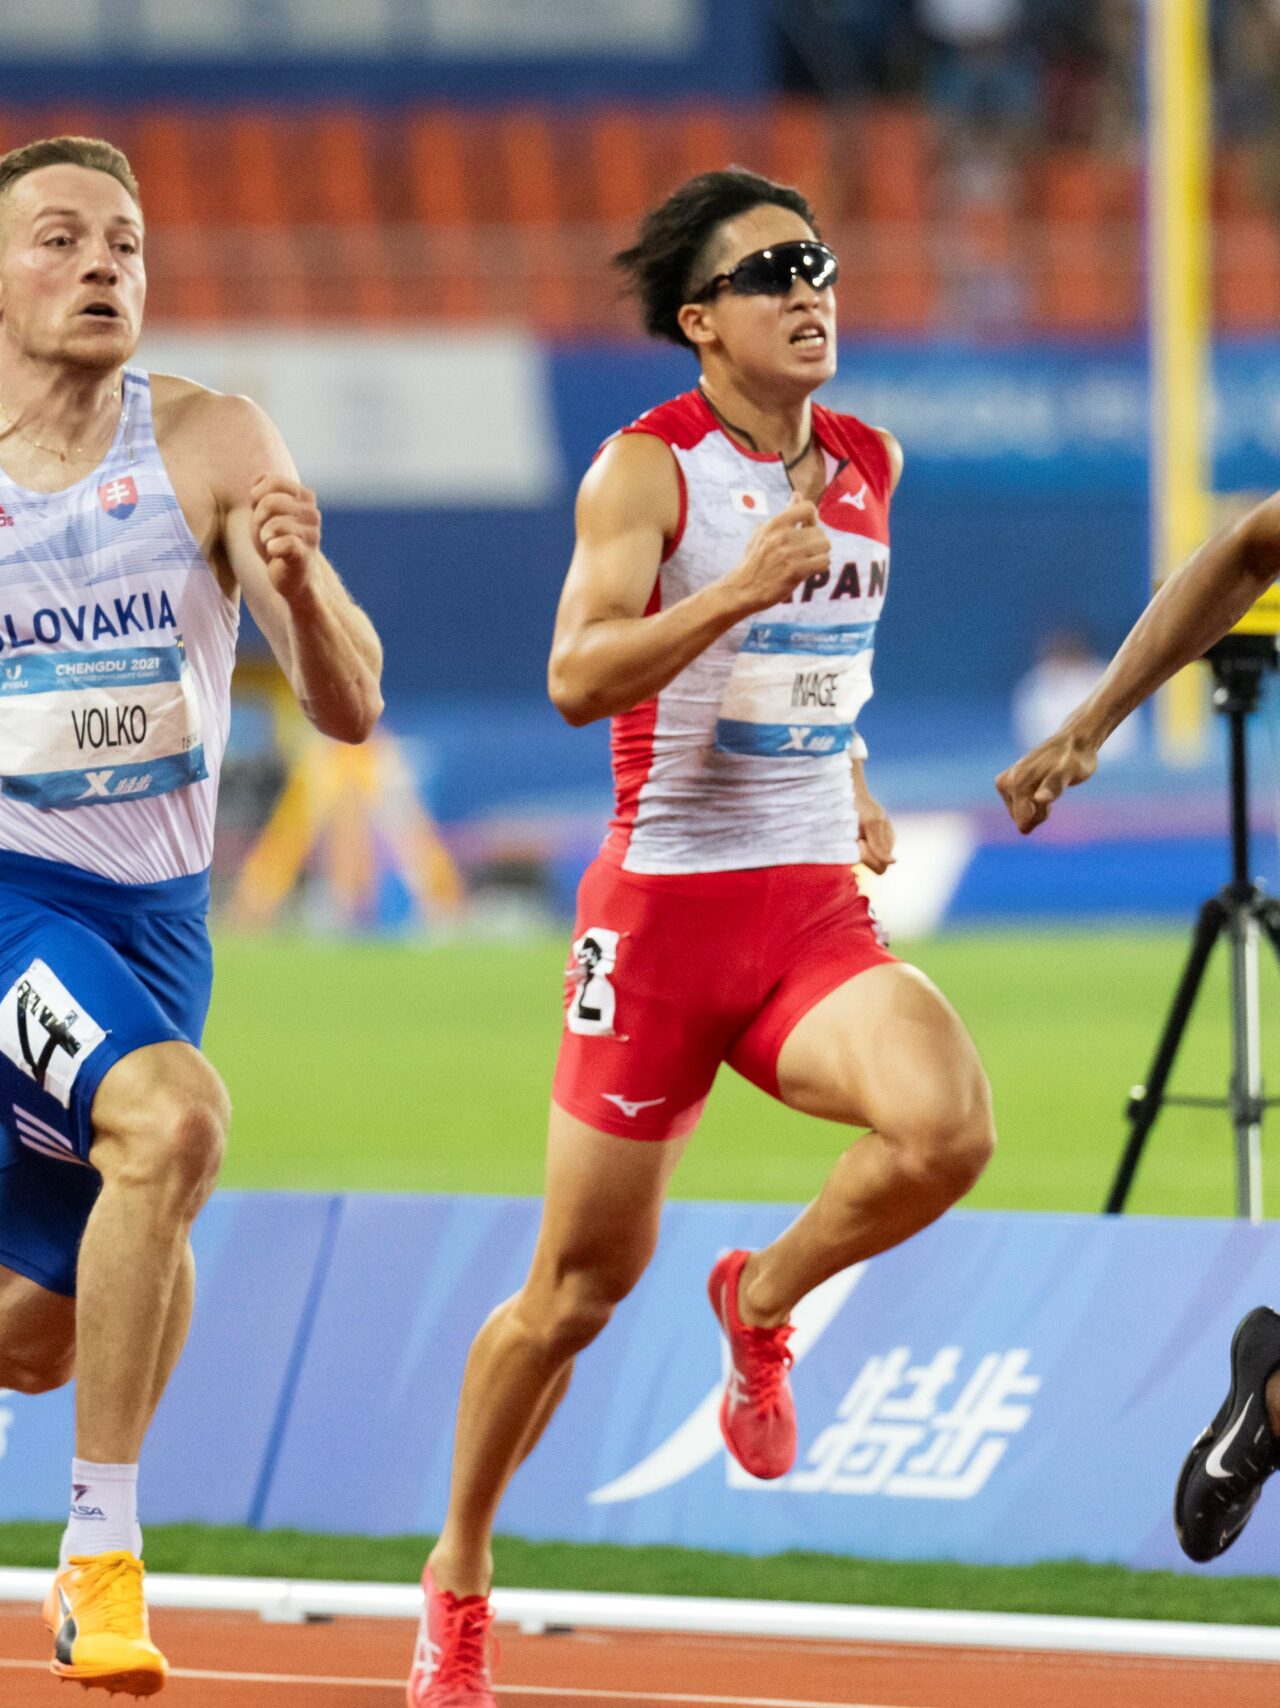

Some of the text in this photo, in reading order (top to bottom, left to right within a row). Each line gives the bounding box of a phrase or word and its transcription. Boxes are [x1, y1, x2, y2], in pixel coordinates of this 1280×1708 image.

[780, 560, 887, 604] PAN
[55, 656, 160, 677] CHENGDU 2021
[71, 704, 147, 750] VOLKO
[784, 1345, 1043, 1501] 特步
